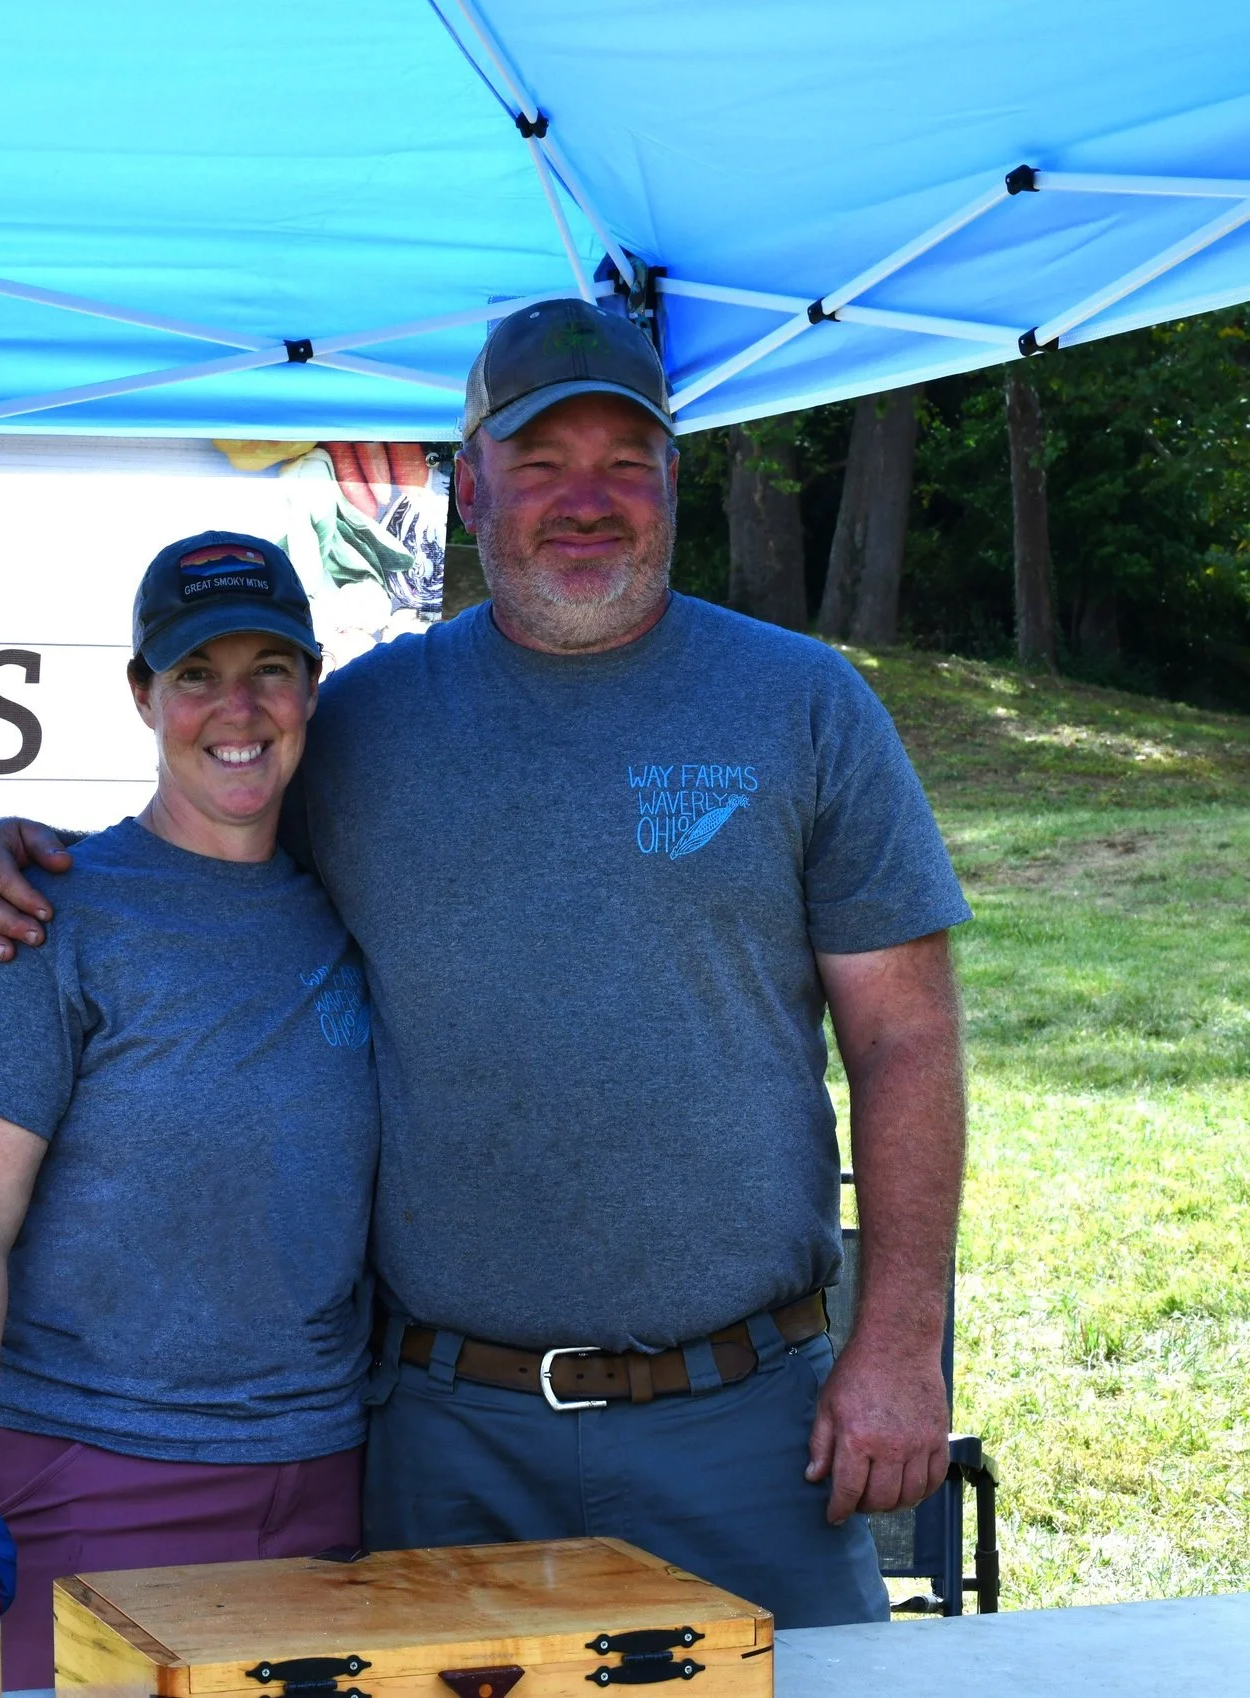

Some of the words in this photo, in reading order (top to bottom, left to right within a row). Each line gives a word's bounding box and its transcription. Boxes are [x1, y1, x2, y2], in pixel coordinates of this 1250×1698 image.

[184, 580, 211, 595] GREAT
[213, 577, 245, 587] SMOKY
[246, 577, 269, 590] MTNS
[629, 765, 674, 788] WAY
[681, 764, 758, 791] FARMS
[638, 790, 728, 821] WAVERLY
[637, 816, 689, 853] OHIO
